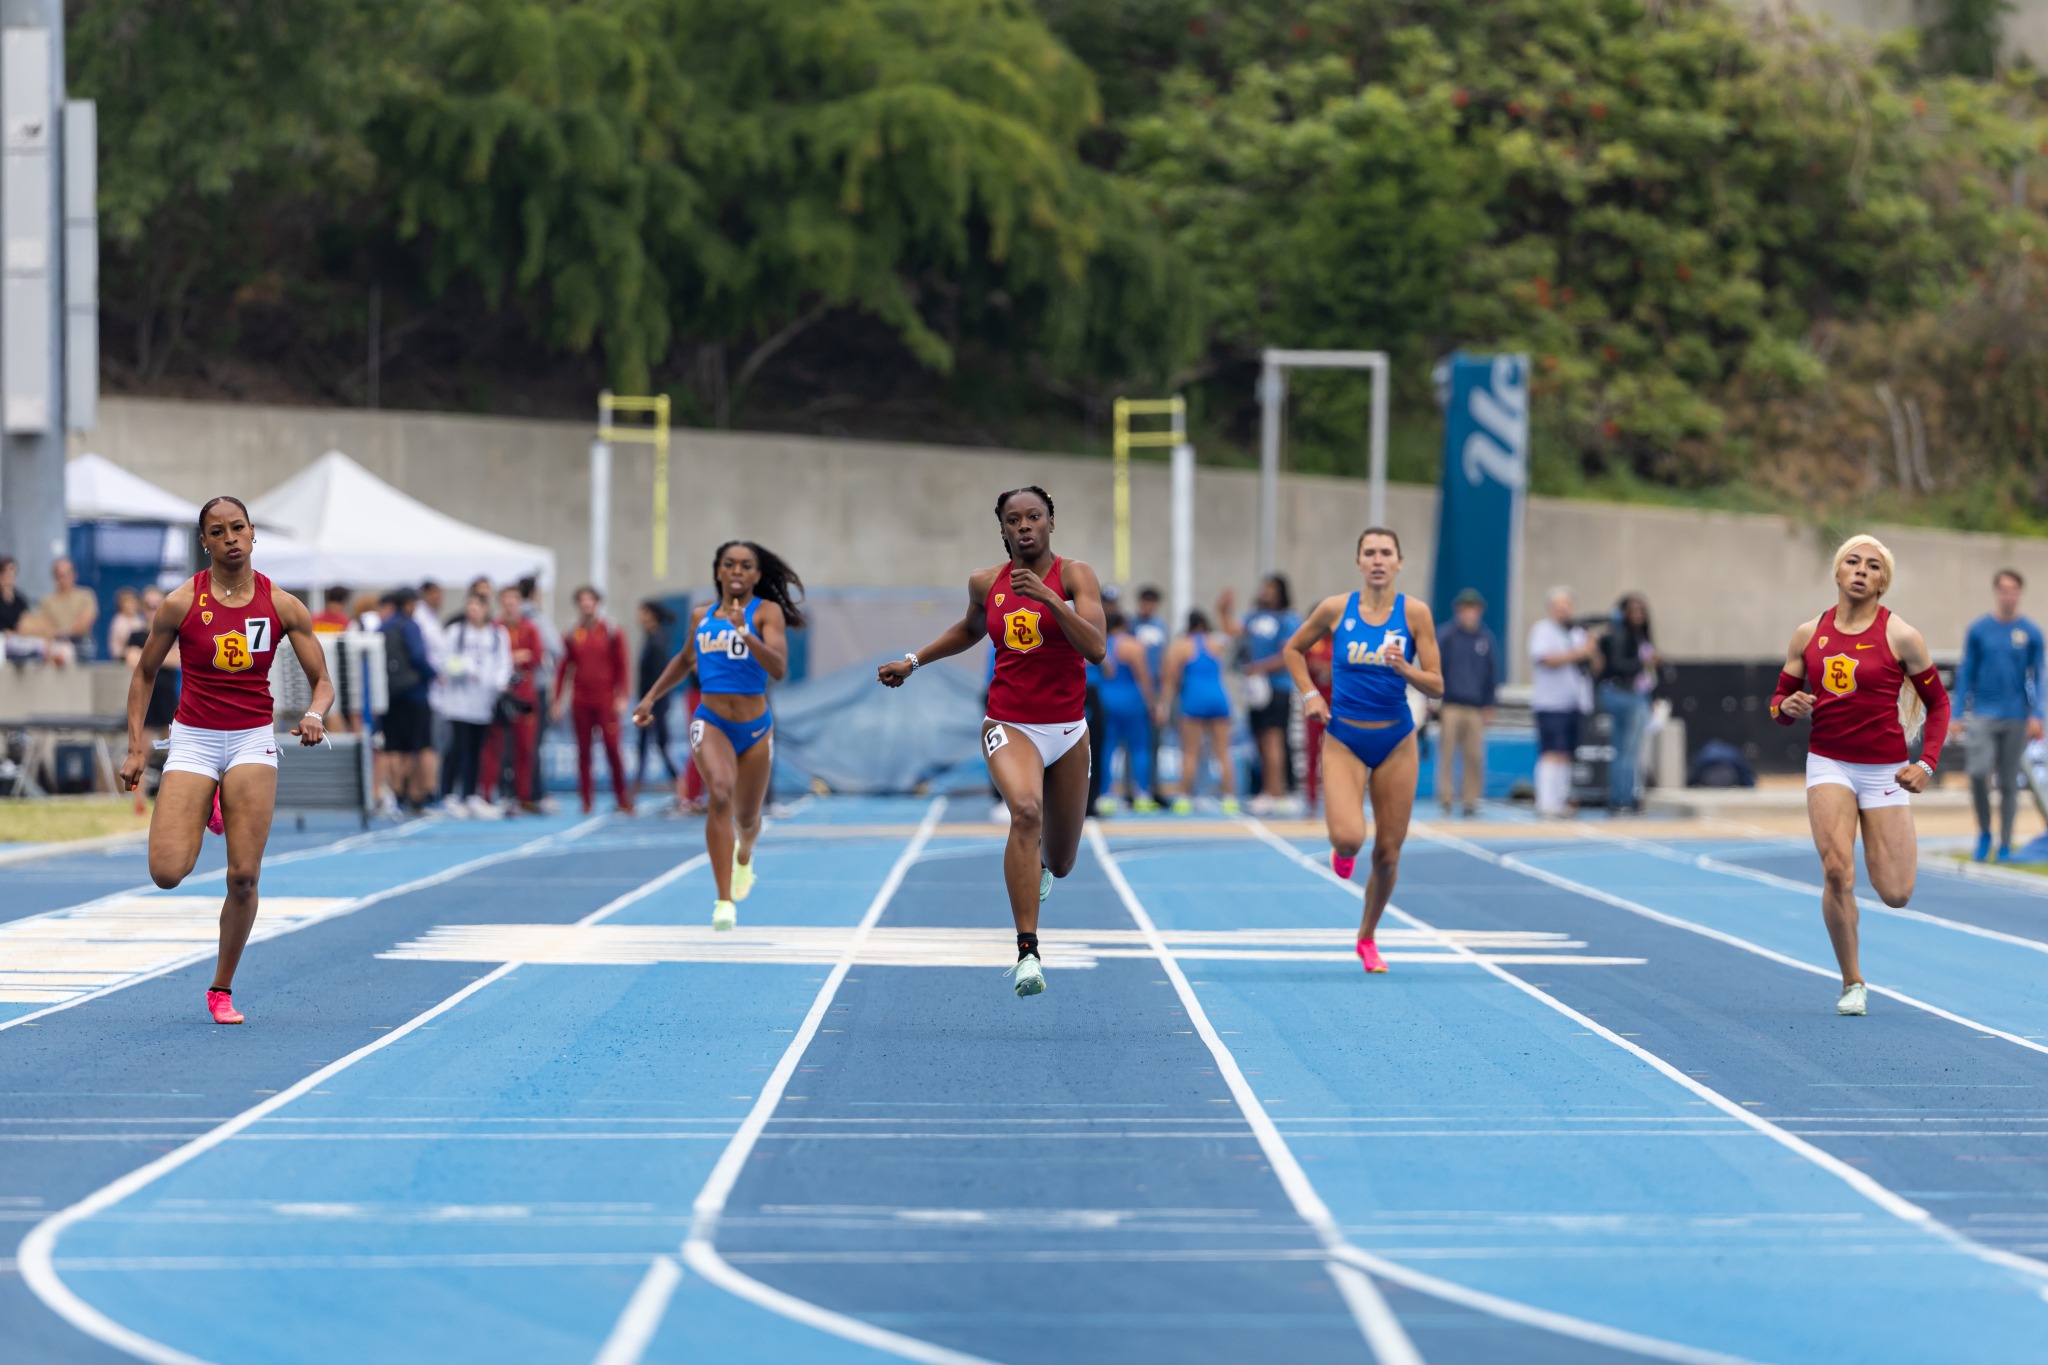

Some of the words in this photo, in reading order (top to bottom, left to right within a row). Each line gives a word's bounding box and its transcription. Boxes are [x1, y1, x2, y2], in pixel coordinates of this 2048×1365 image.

[199, 593, 208, 607] C
[248, 620, 266, 650] 7
[1012, 616, 1033, 645] SC
[223, 638, 243, 667] SC
[732, 636, 745, 656] 6
[1831, 661, 1847, 689] SC
[986, 725, 1003, 752] 5
